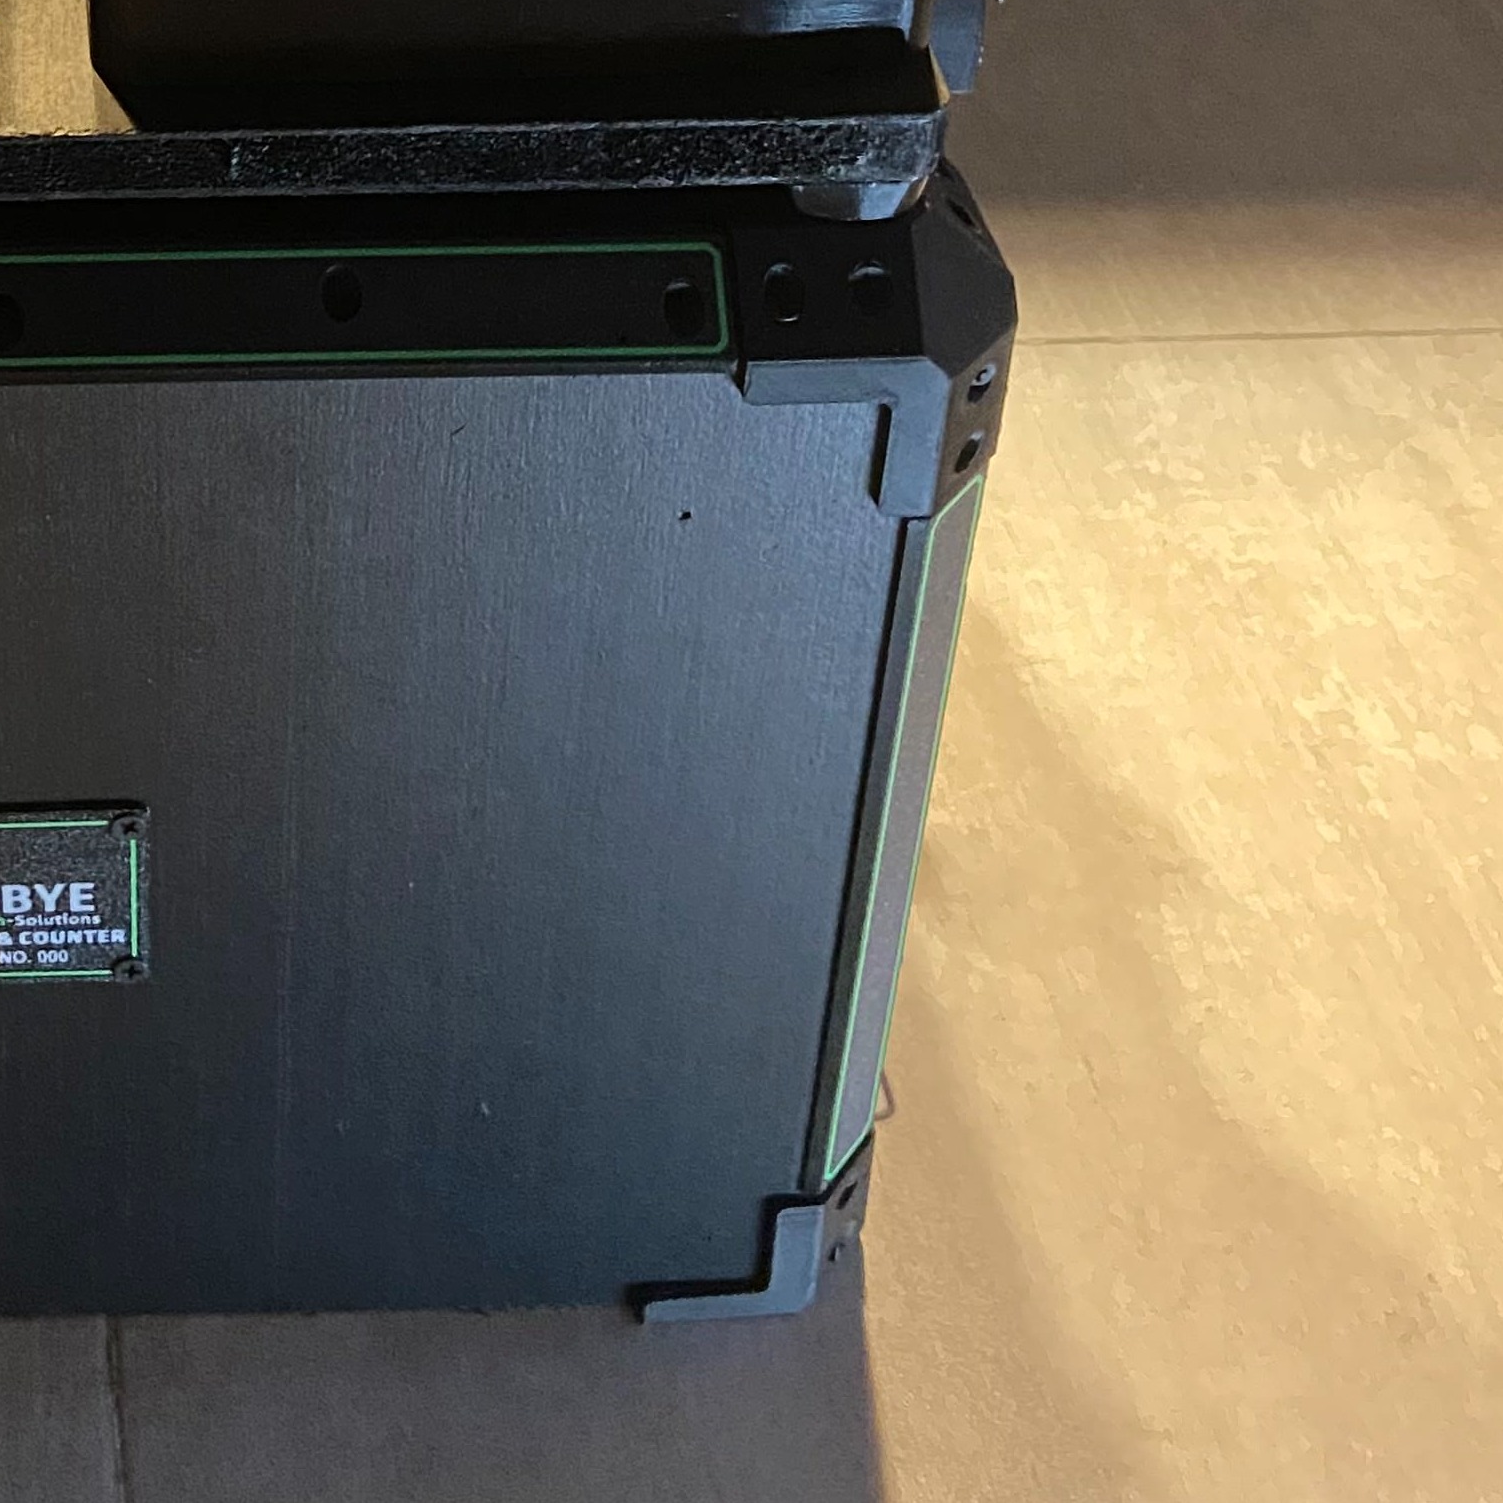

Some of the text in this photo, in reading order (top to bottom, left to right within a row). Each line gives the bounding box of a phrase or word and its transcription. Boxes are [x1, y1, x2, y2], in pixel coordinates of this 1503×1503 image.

[19, 929, 126, 946] COUNTER
[0, 950, 32, 964] NO.
[37, 949, 69, 963] 000
